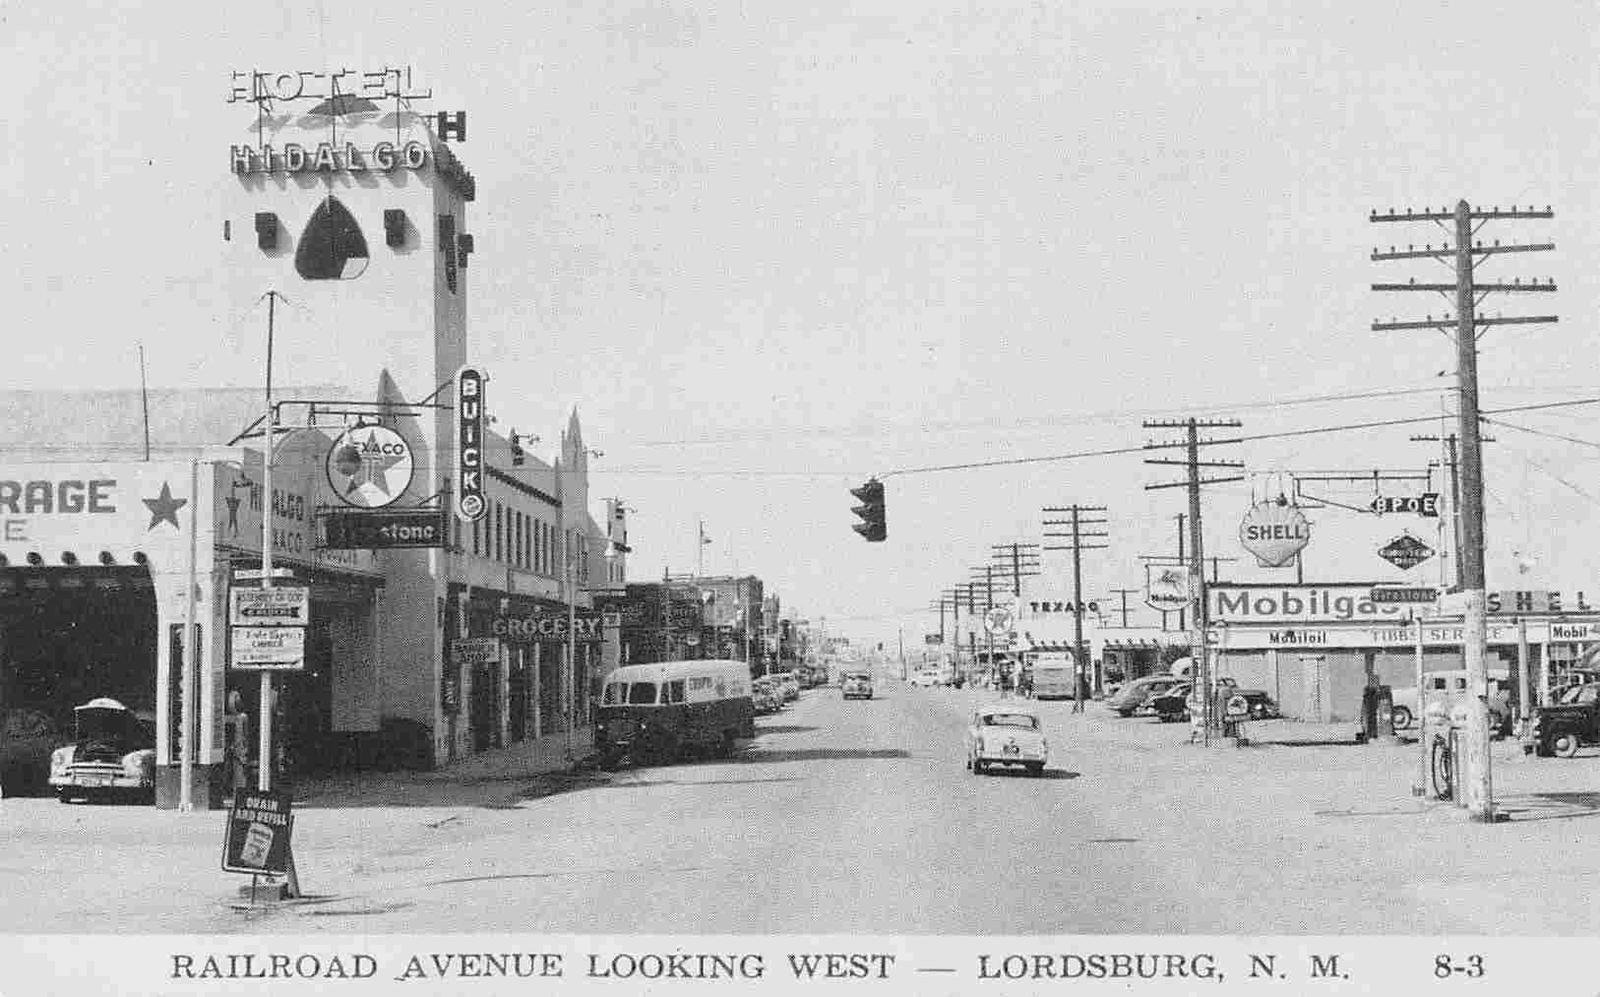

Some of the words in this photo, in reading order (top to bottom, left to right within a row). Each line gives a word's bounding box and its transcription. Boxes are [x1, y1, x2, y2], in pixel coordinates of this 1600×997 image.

[227, 66, 432, 103] HOTEL
[230, 140, 427, 174] HIDALGO
[462, 378, 478, 490] BUICK
[350, 442, 404, 455] XACO
[0, 480, 116, 513] RAGE
[250, 482, 304, 521] HIALGO
[1376, 495, 1435, 514] BPOE
[1247, 524, 1304, 541] SHELL
[1029, 602, 1099, 613] TEXACO
[492, 617, 600, 637] GROCERY
[1553, 627, 1588, 639] Mobil
[1269, 630, 1327, 644] Mobiloil
